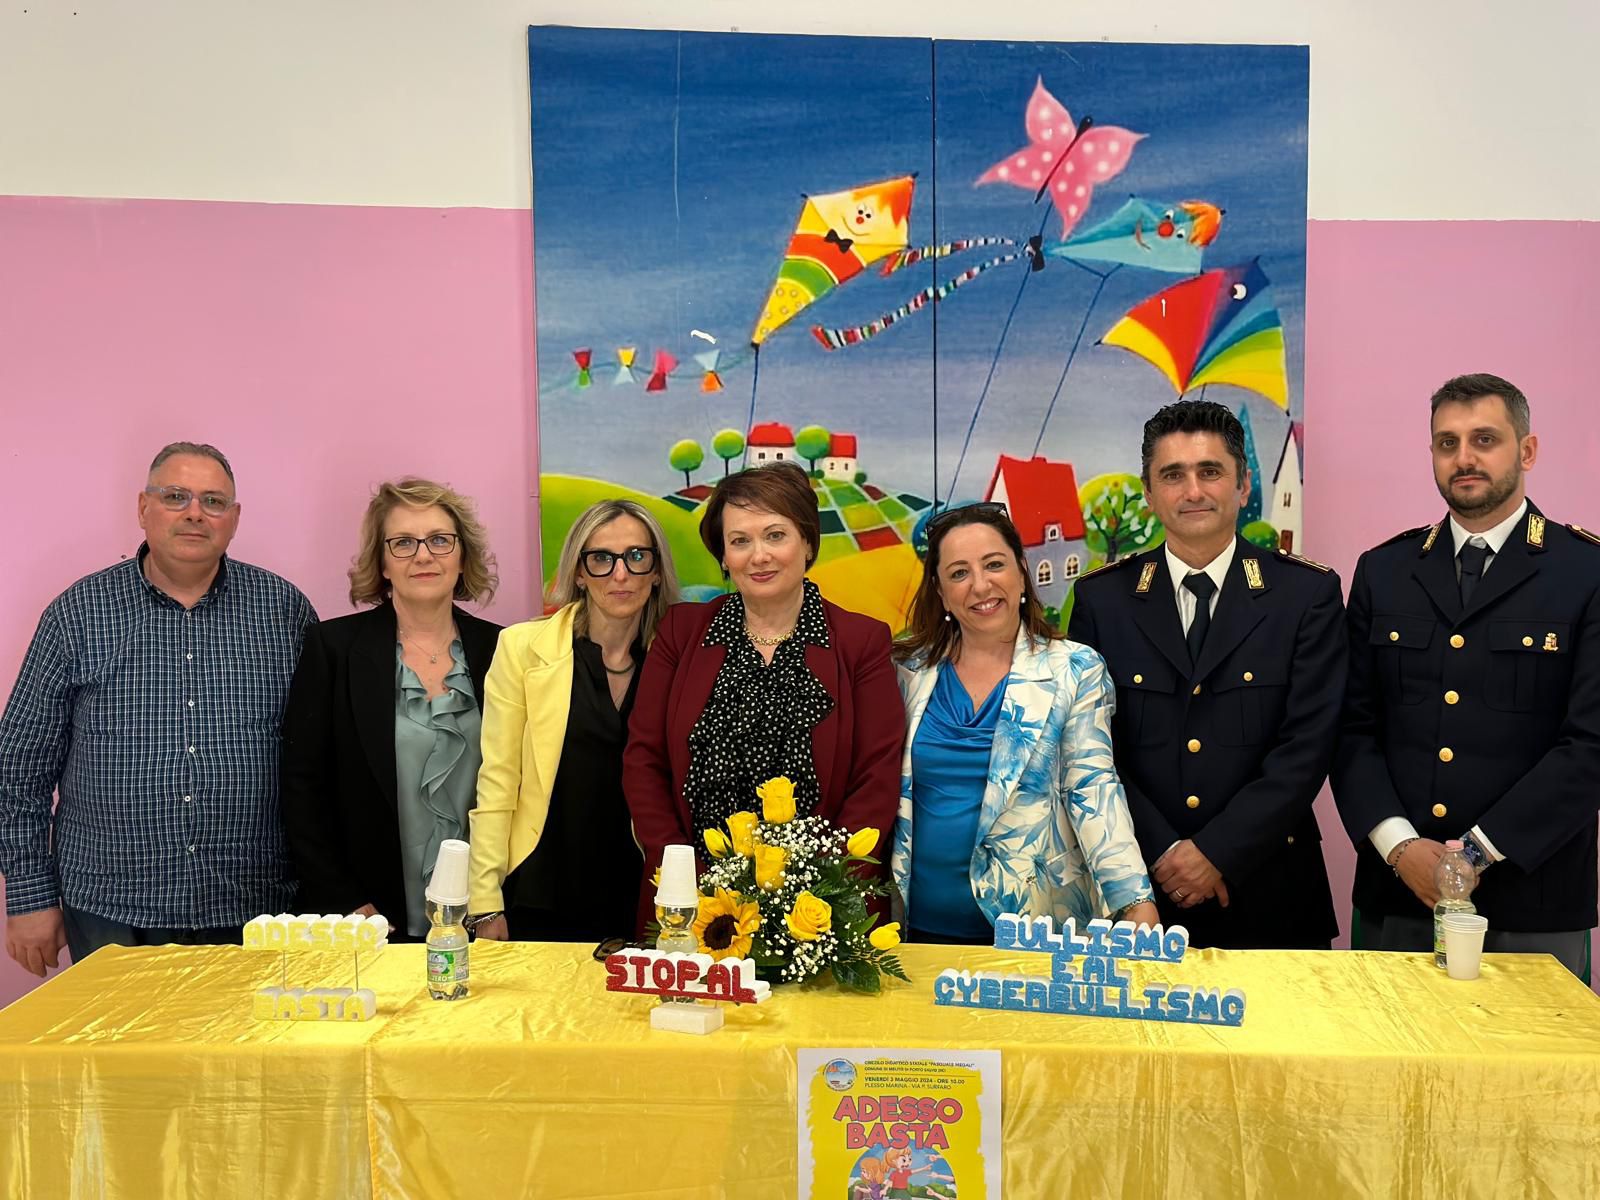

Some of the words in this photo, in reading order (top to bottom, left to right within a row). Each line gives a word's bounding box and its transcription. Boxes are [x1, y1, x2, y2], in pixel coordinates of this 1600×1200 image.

[243, 919, 382, 950] ADESSO
[994, 917, 1186, 962] BULLISMO
[605, 954, 700, 994] STOP
[707, 963, 758, 1004] AL
[1052, 953, 1074, 984] E
[1082, 956, 1128, 987] AL
[254, 991, 368, 1021] BASTA
[934, 975, 1244, 1026] CYBERBULLISMO
[833, 1095, 963, 1124] ADESSO
[846, 1122, 949, 1149] BASTA
